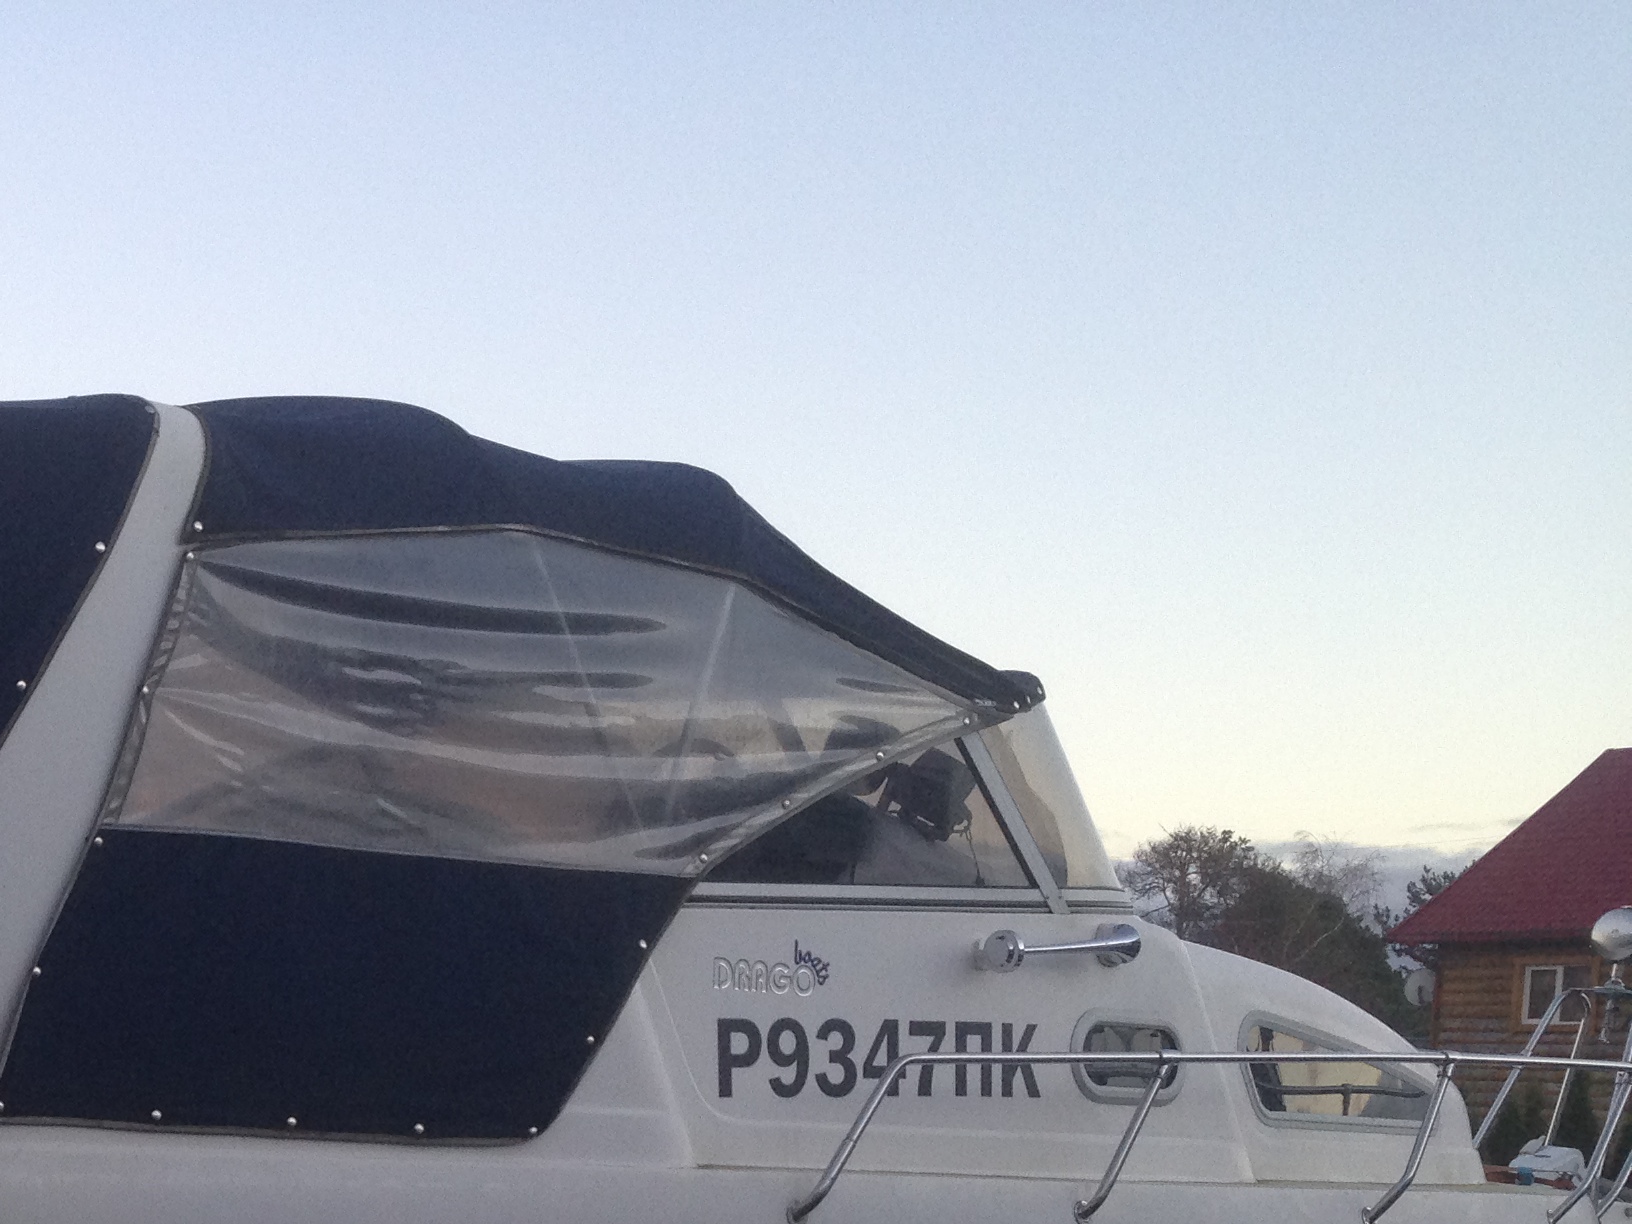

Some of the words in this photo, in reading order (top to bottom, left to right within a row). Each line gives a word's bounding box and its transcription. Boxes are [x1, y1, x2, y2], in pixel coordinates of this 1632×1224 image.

[712, 956, 816, 997] DRAGO
[794, 939, 830, 986] boats
[717, 1017, 1042, 1098] Р9347ПК
